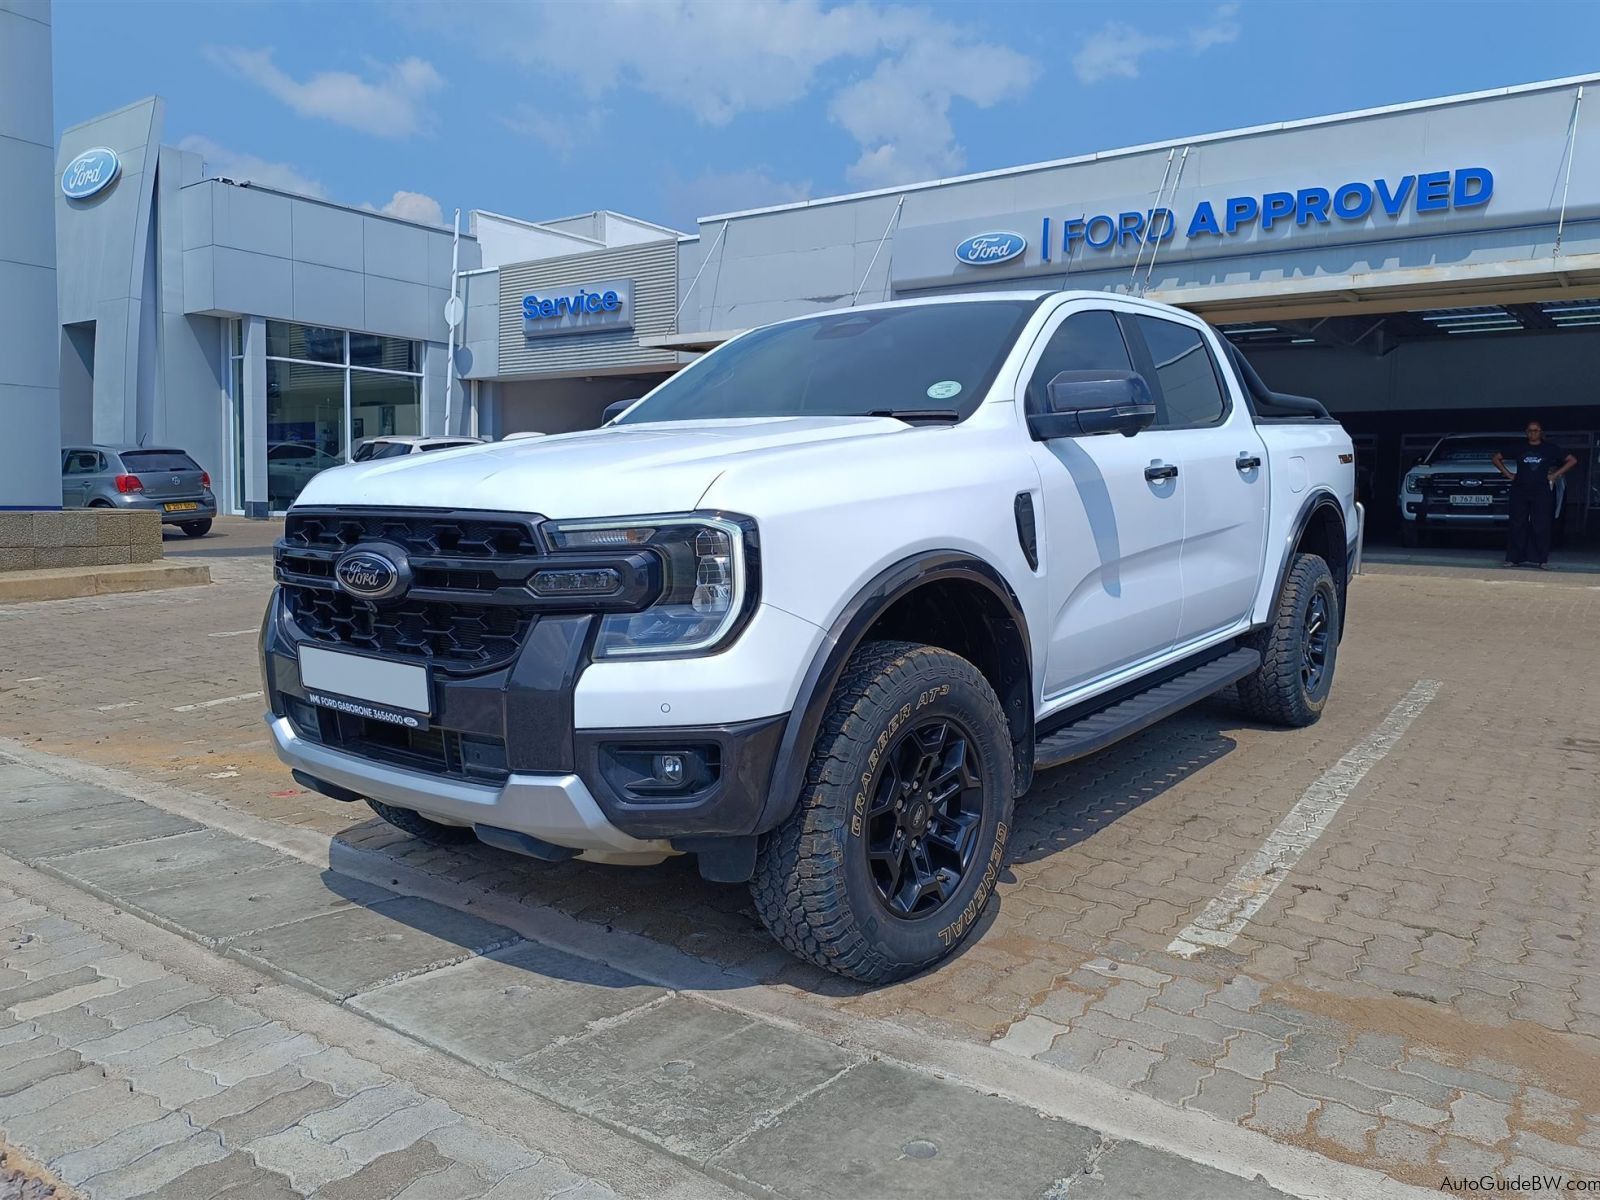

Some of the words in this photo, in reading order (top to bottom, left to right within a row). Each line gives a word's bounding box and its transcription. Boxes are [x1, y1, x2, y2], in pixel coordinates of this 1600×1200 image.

[69, 157, 104, 189] Ford
[1063, 207, 1175, 252] FORD
[1186, 167, 1494, 238] APPROVED
[968, 237, 1011, 260] Ford
[522, 289, 620, 320] Service
[346, 561, 379, 586] Ford
[320, 697, 337, 708] FORD
[337, 701, 373, 718] GABORONE
[373, 709, 403, 724] 3656000
[852, 703, 911, 837] GRABBER
[938, 821, 1008, 946] GENERAL
